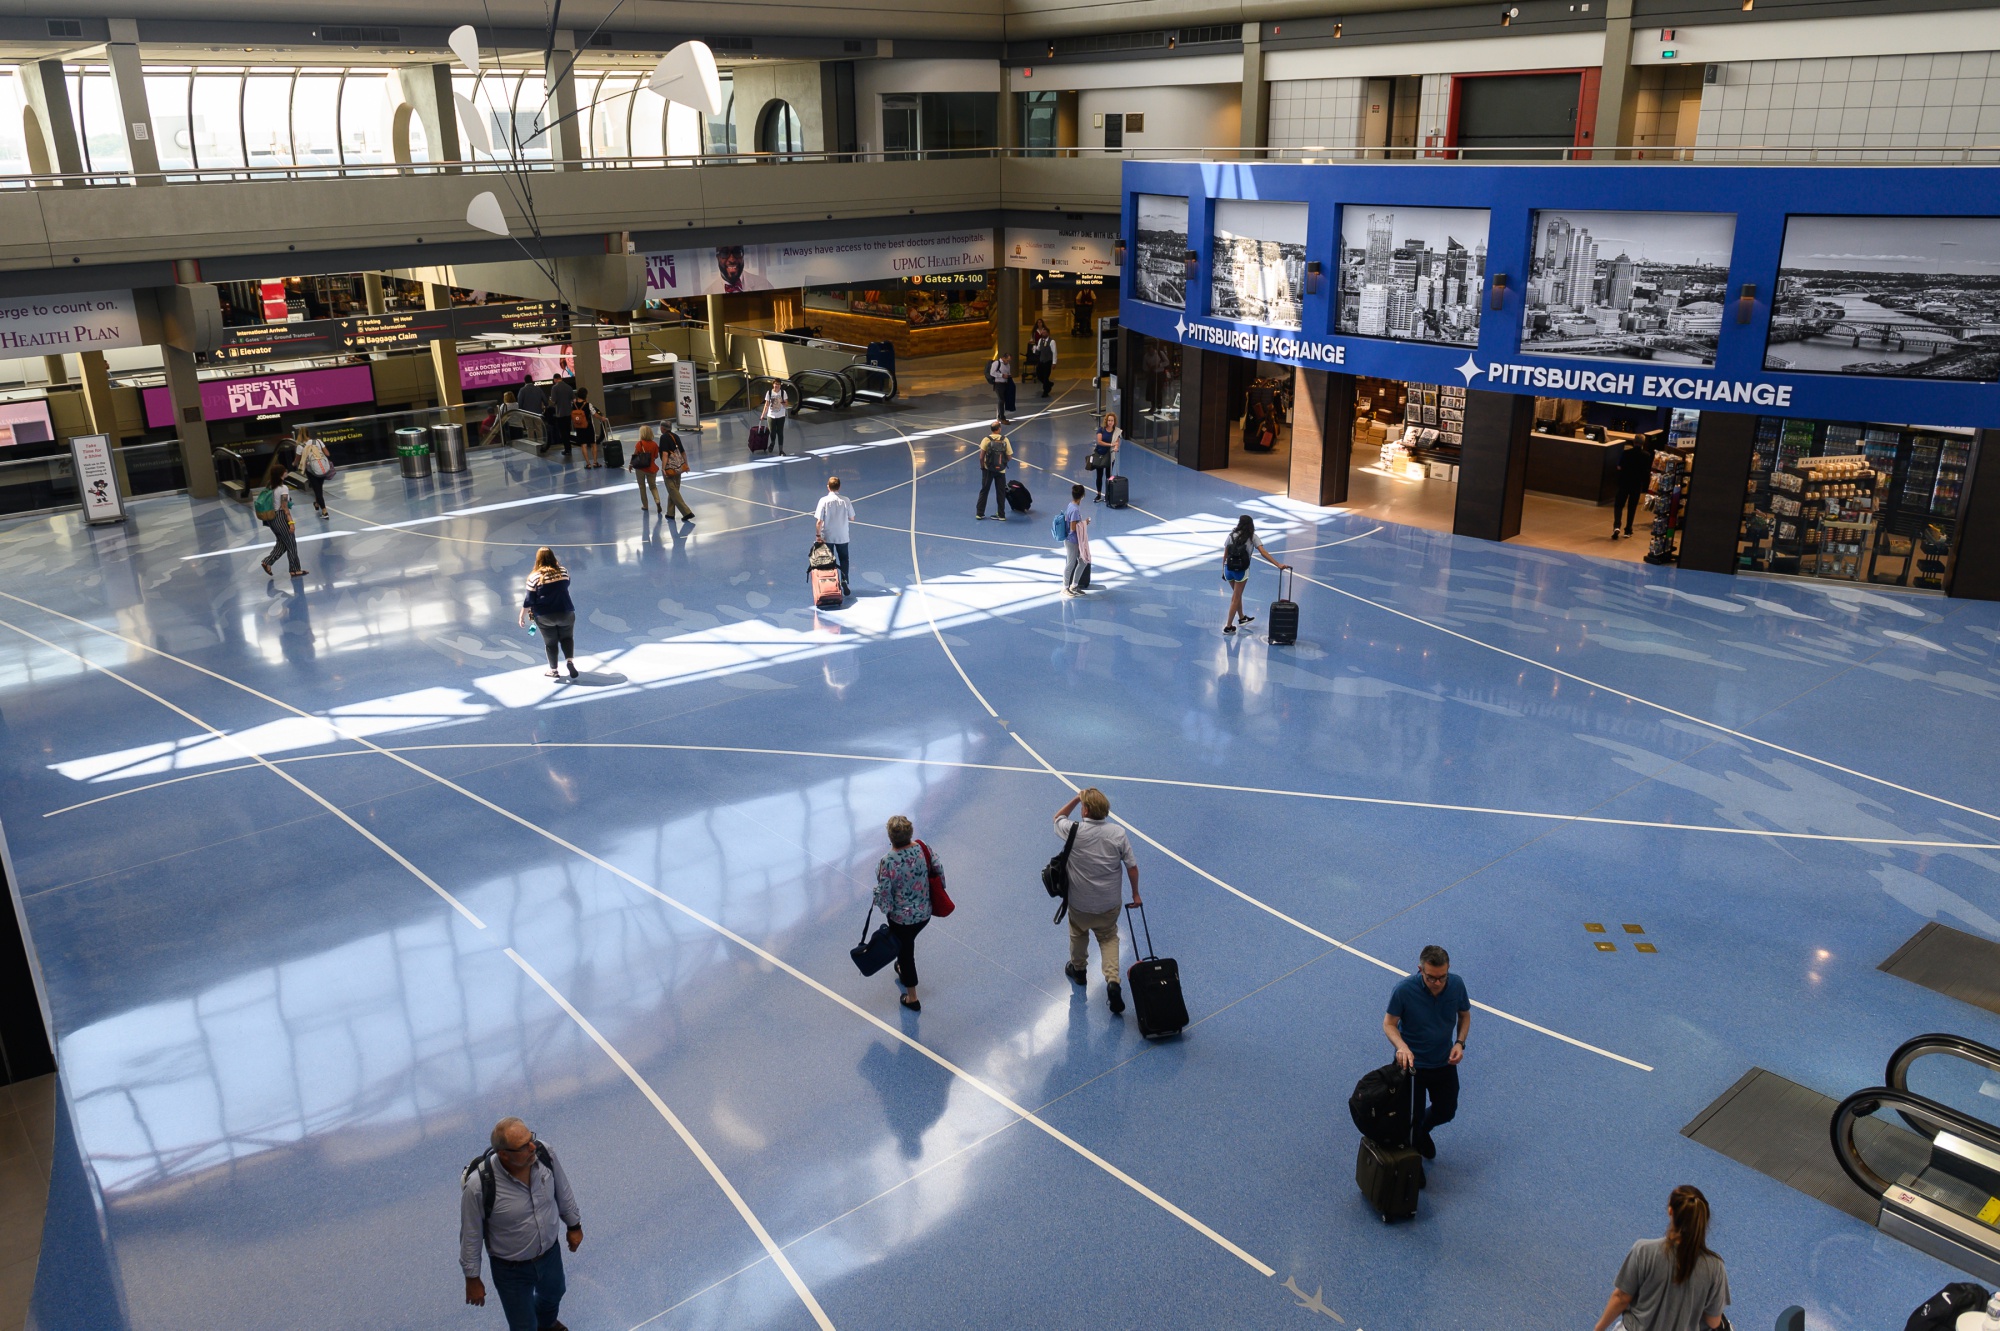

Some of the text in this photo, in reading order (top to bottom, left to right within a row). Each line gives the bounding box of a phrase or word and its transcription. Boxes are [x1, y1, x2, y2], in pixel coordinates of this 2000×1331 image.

[1058, 230, 1080, 238] HUNGRY?
[1081, 231, 1092, 239] DINE
[1094, 232, 1106, 240] WITH
[784, 233, 986, 258] Always have access to the best doctors and hospitals.
[651, 254, 674, 267] THE
[893, 252, 985, 271] UPMC HEALTH PLAN
[924, 274, 952, 283] Gates
[954, 274, 983, 283] 76-100
[32, 305, 48, 316] to
[52, 301, 92, 314] count
[96, 301, 118, 311] on.
[512, 321, 539, 329] Elevator
[0, 326, 120, 348] HEALTH PLAN
[236, 328, 268, 336] International
[366, 332, 418, 344] Baggage Claim
[1188, 322, 1345, 365] PITTSBURGH EXCHANGE
[240, 346, 272, 356] Elevator
[469, 369, 501, 377] CONVENIENT
[226, 378, 296, 394] HERE'S THE
[1488, 362, 1793, 407] PITTSBURGH EXCHANGE
[228, 387, 300, 414] PLAN
[322, 434, 347, 443] Baggage
